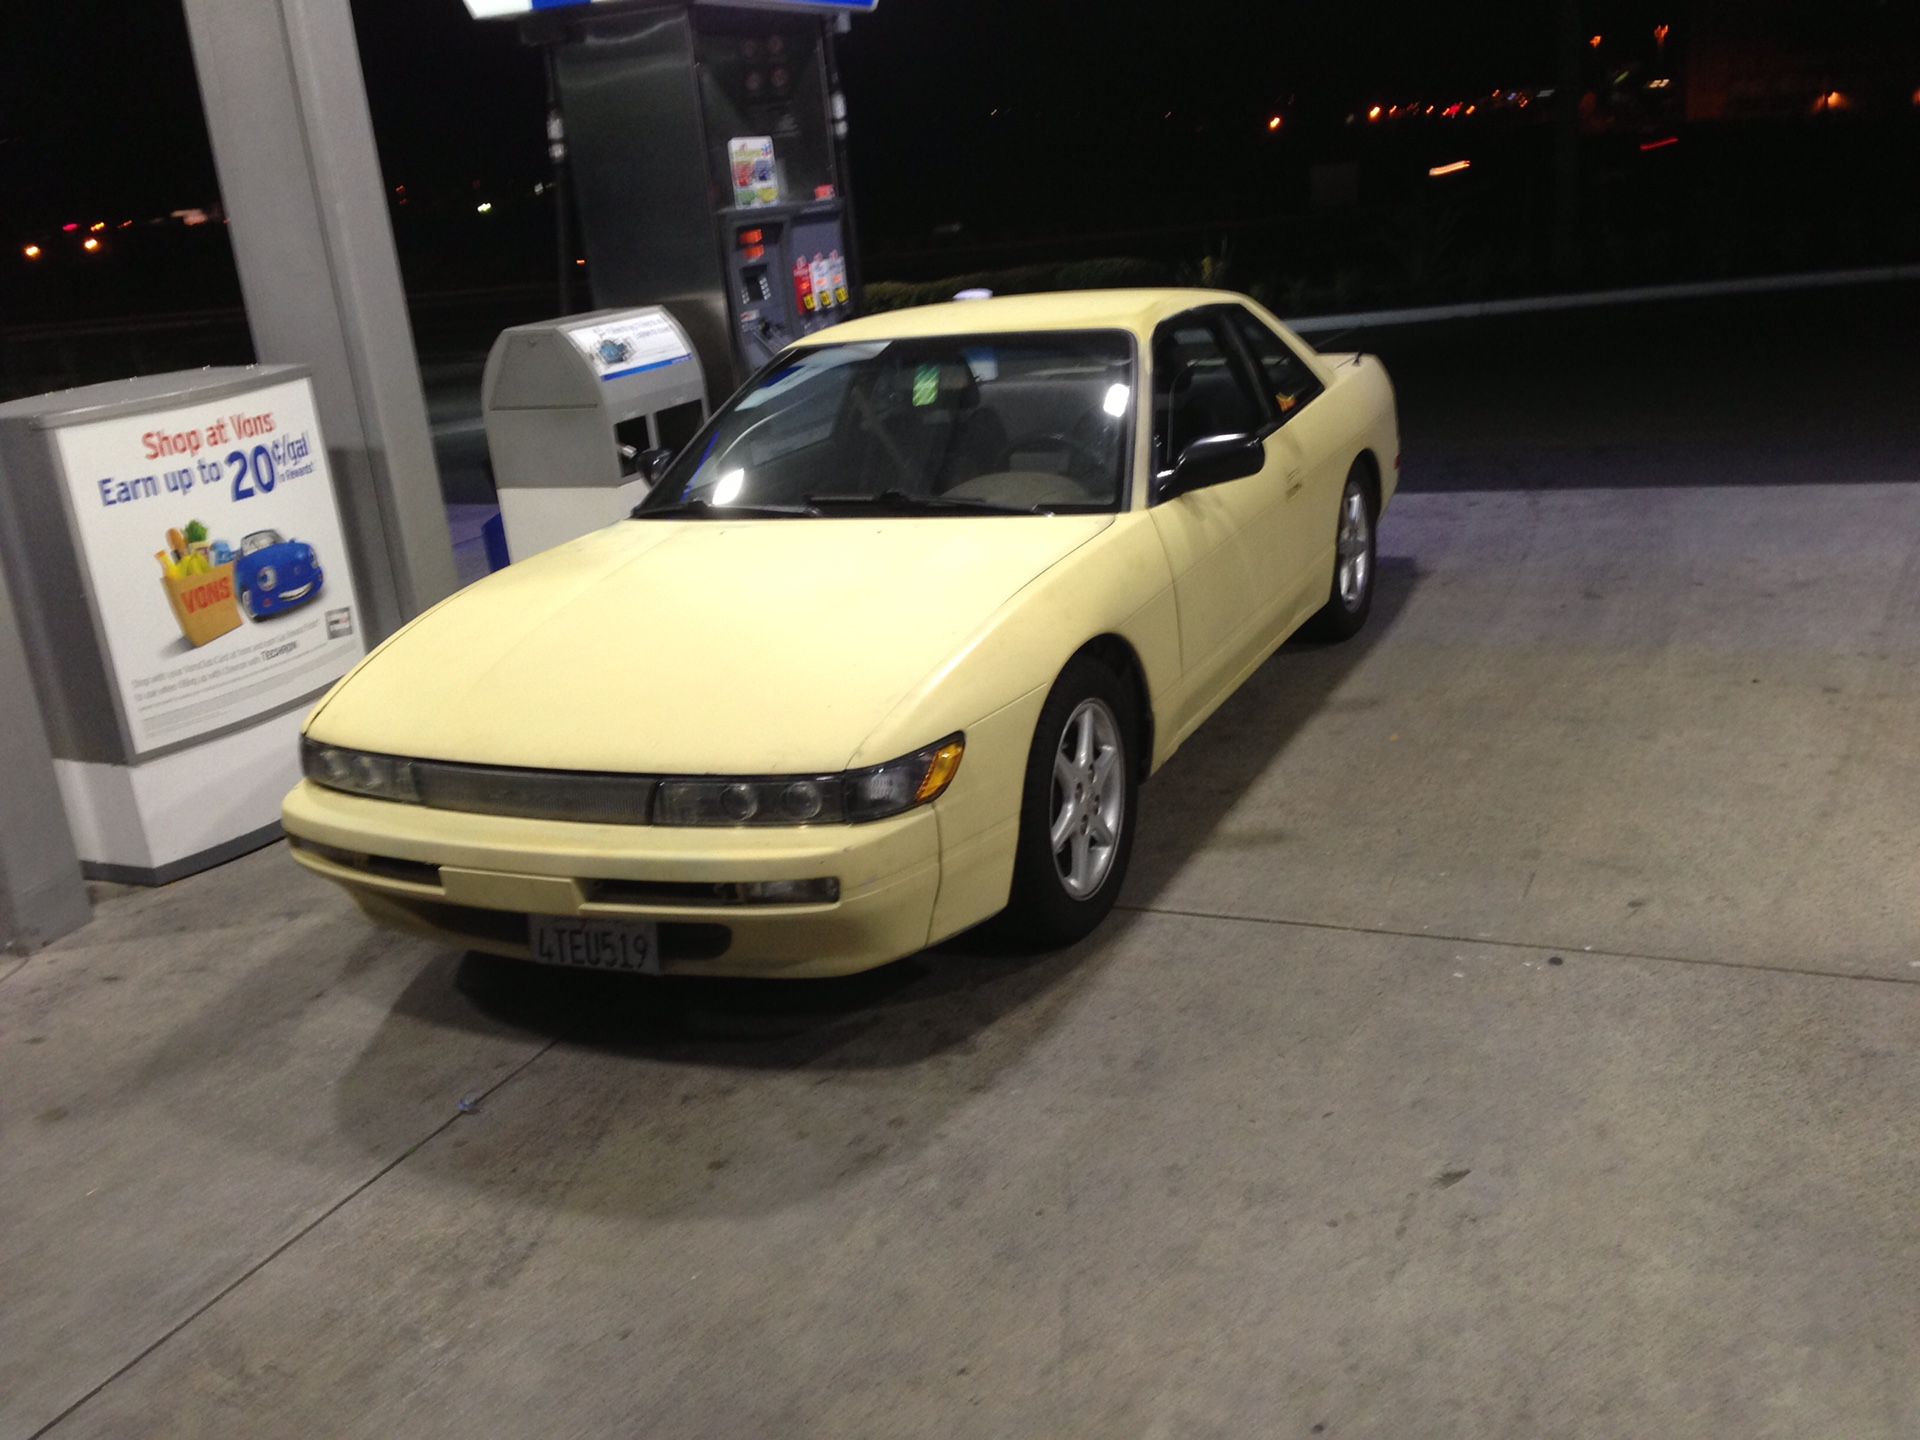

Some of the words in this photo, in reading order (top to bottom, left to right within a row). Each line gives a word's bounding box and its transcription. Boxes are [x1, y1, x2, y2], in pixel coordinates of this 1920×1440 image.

[142, 429, 203, 460] Shop
[206, 418, 229, 447] at
[230, 412, 276, 440] Vons
[97, 475, 160, 506] Earn
[163, 466, 195, 495] up
[197, 458, 224, 484] to
[180, 576, 231, 614] VONS
[538, 926, 648, 969] 4TEU519
